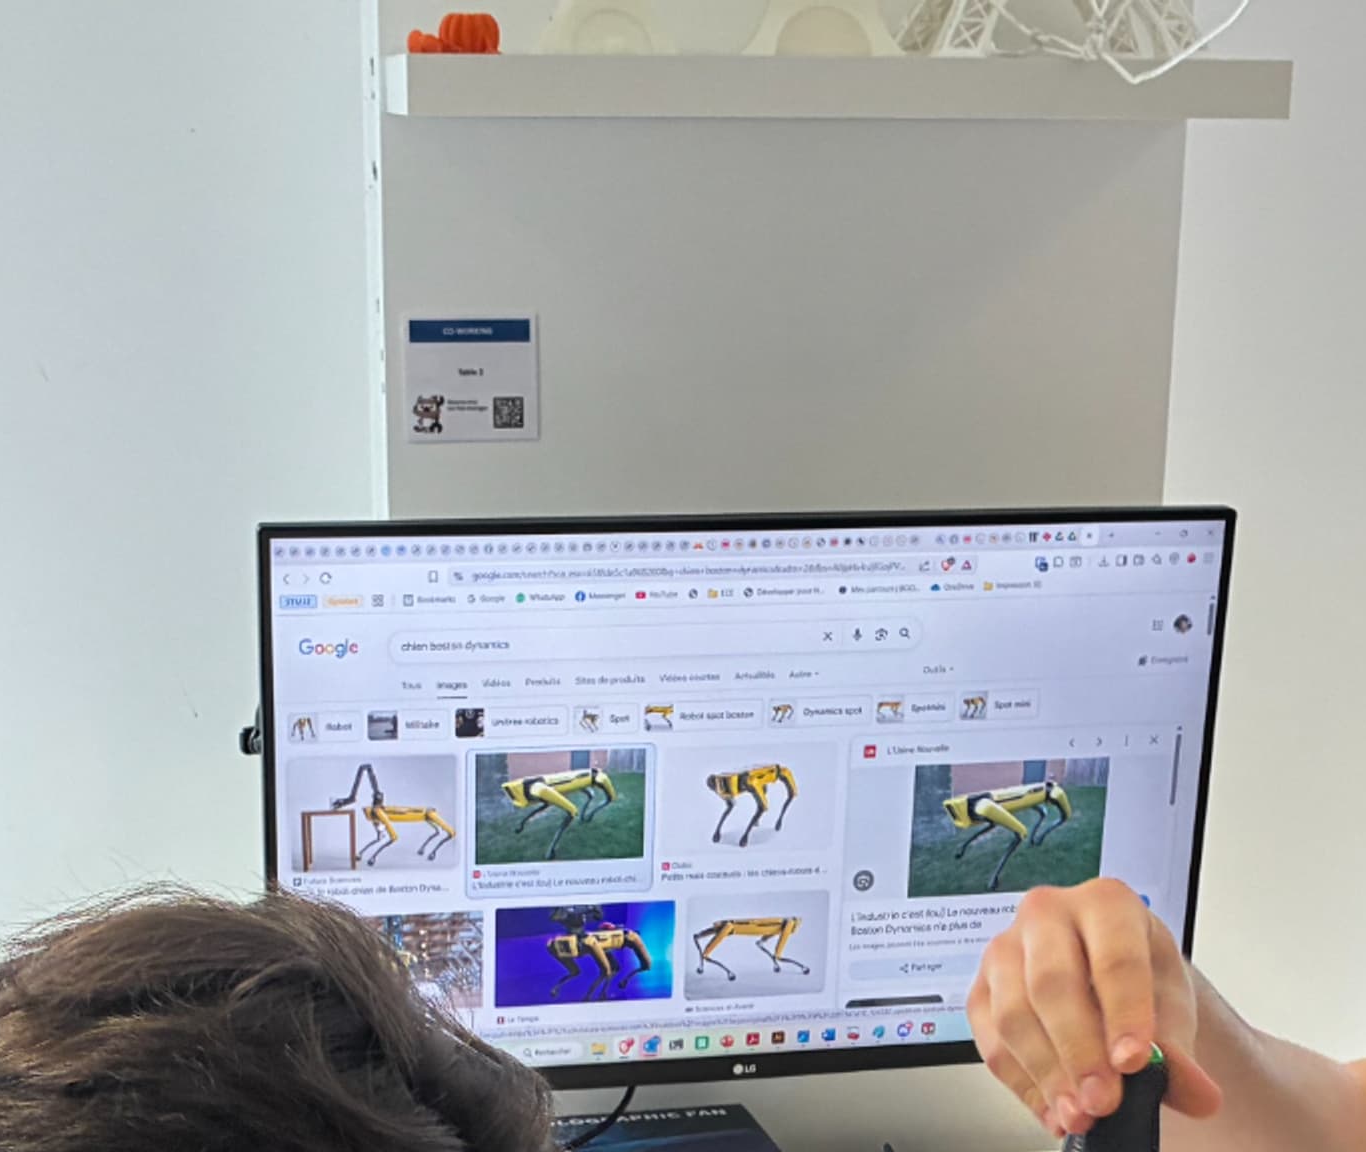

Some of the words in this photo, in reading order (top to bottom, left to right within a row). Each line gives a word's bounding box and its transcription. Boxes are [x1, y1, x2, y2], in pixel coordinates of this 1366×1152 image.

[298, 637, 359, 659] Google
[401, 641, 428, 652] chien
[430, 640, 463, 651] boston
[465, 639, 510, 654] dynamics
[437, 680, 468, 692] Images
[994, 700, 1013, 711] Spot
[1014, 700, 1031, 709] mini
[680, 711, 704, 721] Robot
[706, 710, 725, 721] spot
[803, 707, 843, 718] Dynamics
[845, 706, 862, 717] spot
[610, 714, 630, 725] Spot
[326, 721, 353, 731] Robot
[947, 907, 958, 917] Le
[960, 906, 1001, 916] nouveau
[851, 926, 884, 936] Boston
[885, 924, 932, 935] Dynamics
[949, 920, 968, 931] plus
[686, 1107, 727, 1118] FAN
